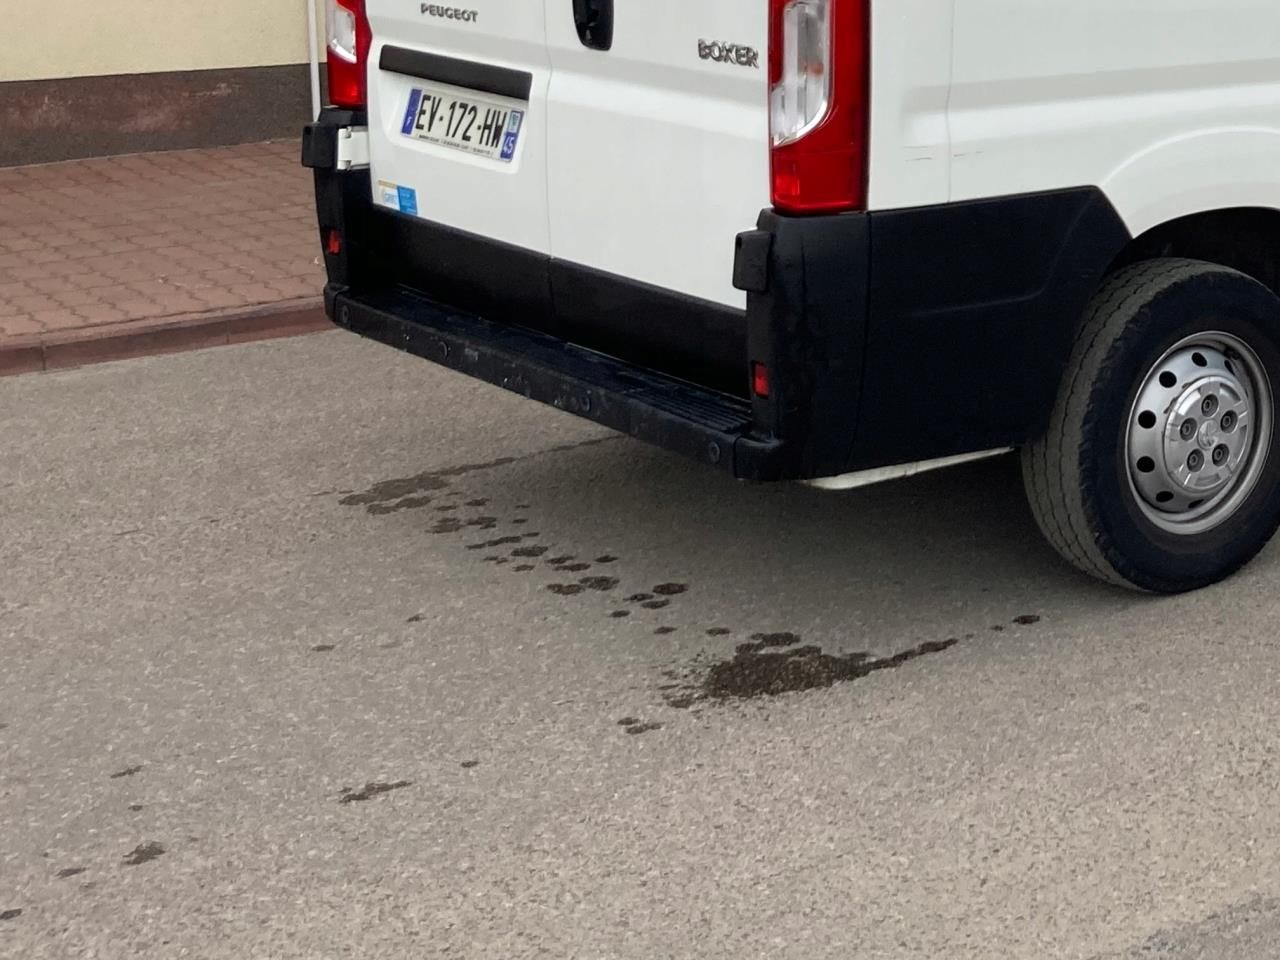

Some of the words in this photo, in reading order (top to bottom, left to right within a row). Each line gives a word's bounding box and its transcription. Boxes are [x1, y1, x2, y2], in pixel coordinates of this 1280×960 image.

[420, 3, 478, 22] PEUGEOT
[698, 39, 759, 68] BOXER
[503, 135, 515, 154] 45
